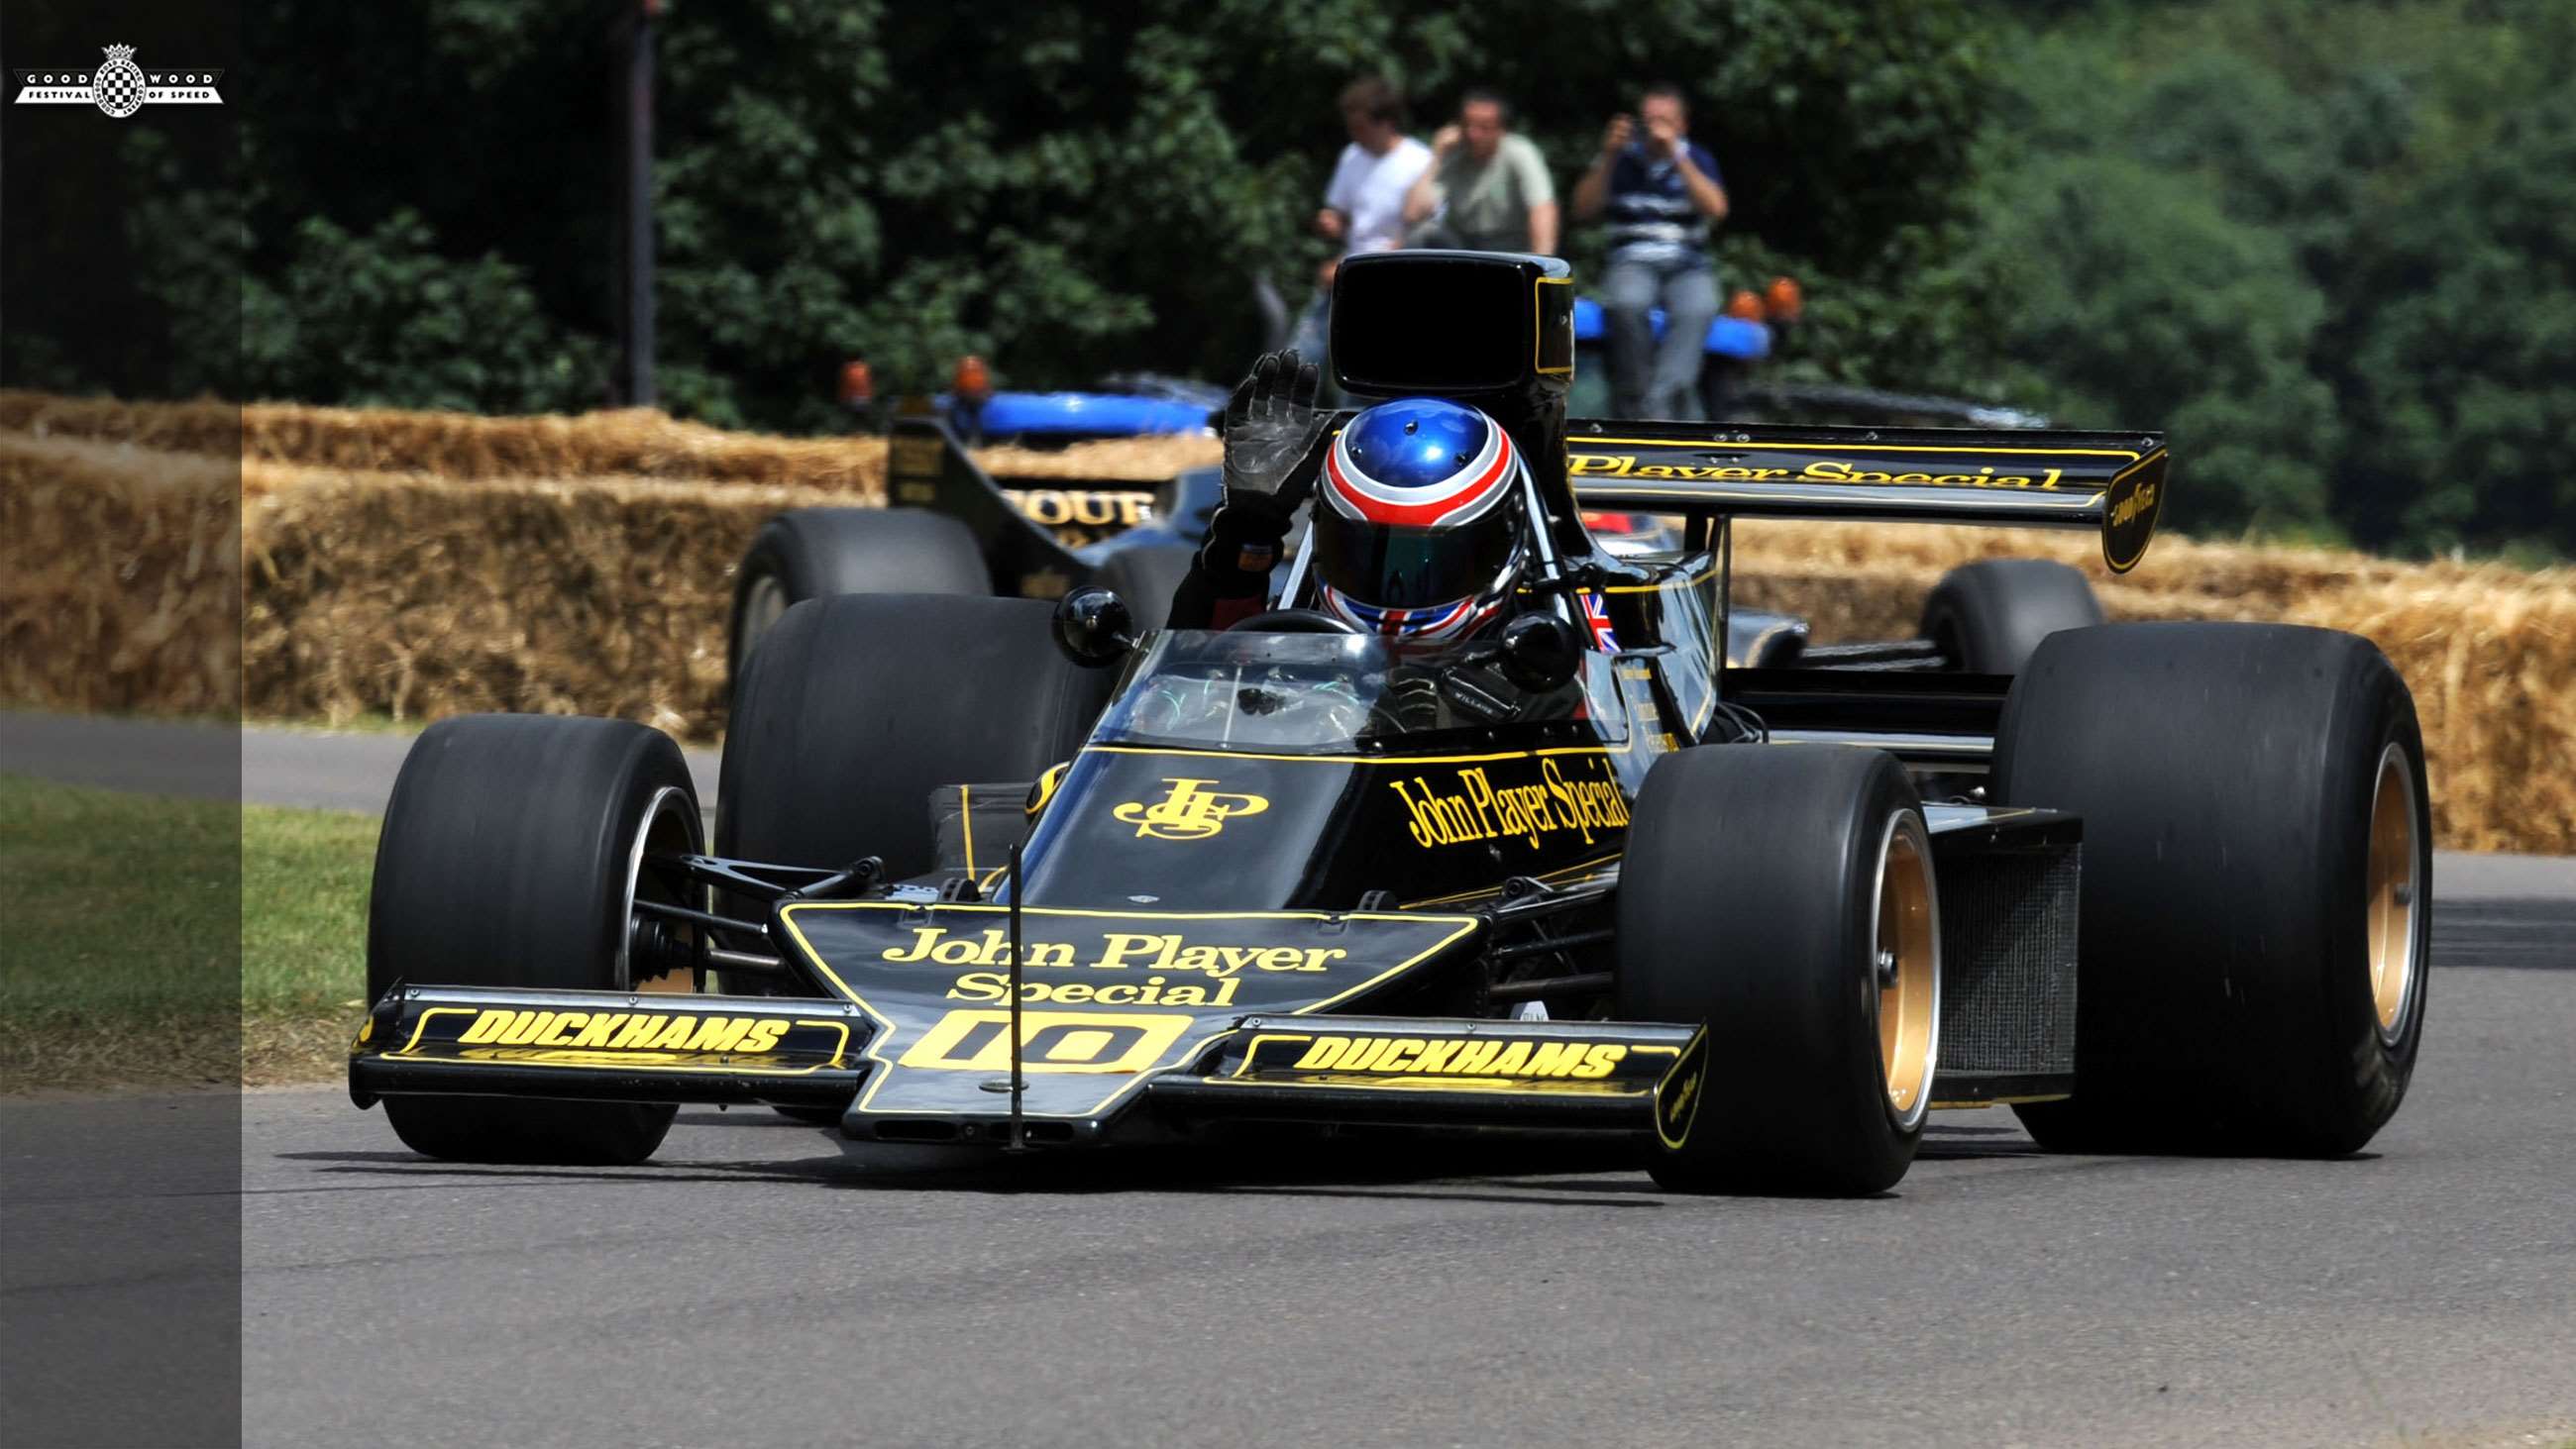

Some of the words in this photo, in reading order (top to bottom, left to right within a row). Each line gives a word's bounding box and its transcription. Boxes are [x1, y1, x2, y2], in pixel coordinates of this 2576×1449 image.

[1388, 776, 1484, 849] John
[1456, 767, 1559, 850] Player
[1541, 757, 1631, 845] Special
[882, 927, 1075, 969] John
[1089, 933, 1348, 979] Player
[945, 972, 1243, 1008] Special
[458, 1009, 791, 1053] DUCKHAMS
[1292, 1035, 1627, 1079] DUCKHAMS
